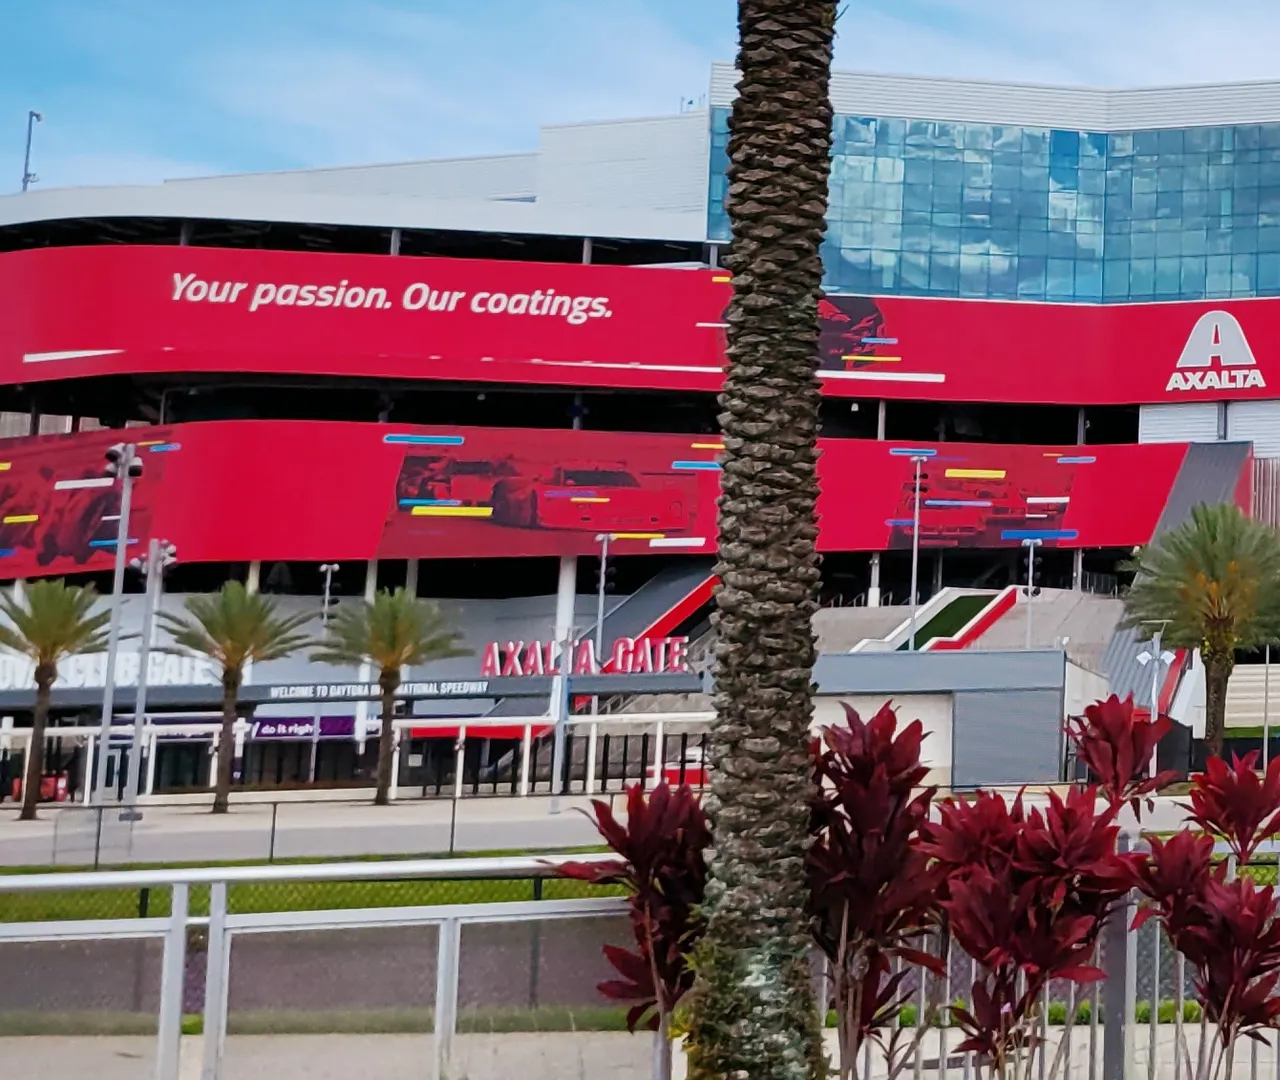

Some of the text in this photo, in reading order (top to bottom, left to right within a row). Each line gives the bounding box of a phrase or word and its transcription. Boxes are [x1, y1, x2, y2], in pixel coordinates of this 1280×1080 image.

[172, 272, 613, 325] Your passion. Our coatings.
[1176, 310, 1257, 368] A
[1165, 369, 1267, 391] AXALTA
[146, 651, 214, 686] GATE
[612, 636, 689, 672] GATE
[270, 681, 489, 698] WELCOME TO DAYTONA INNATIONAL SPEEDWAY
[261, 723, 322, 735] do it righ.
